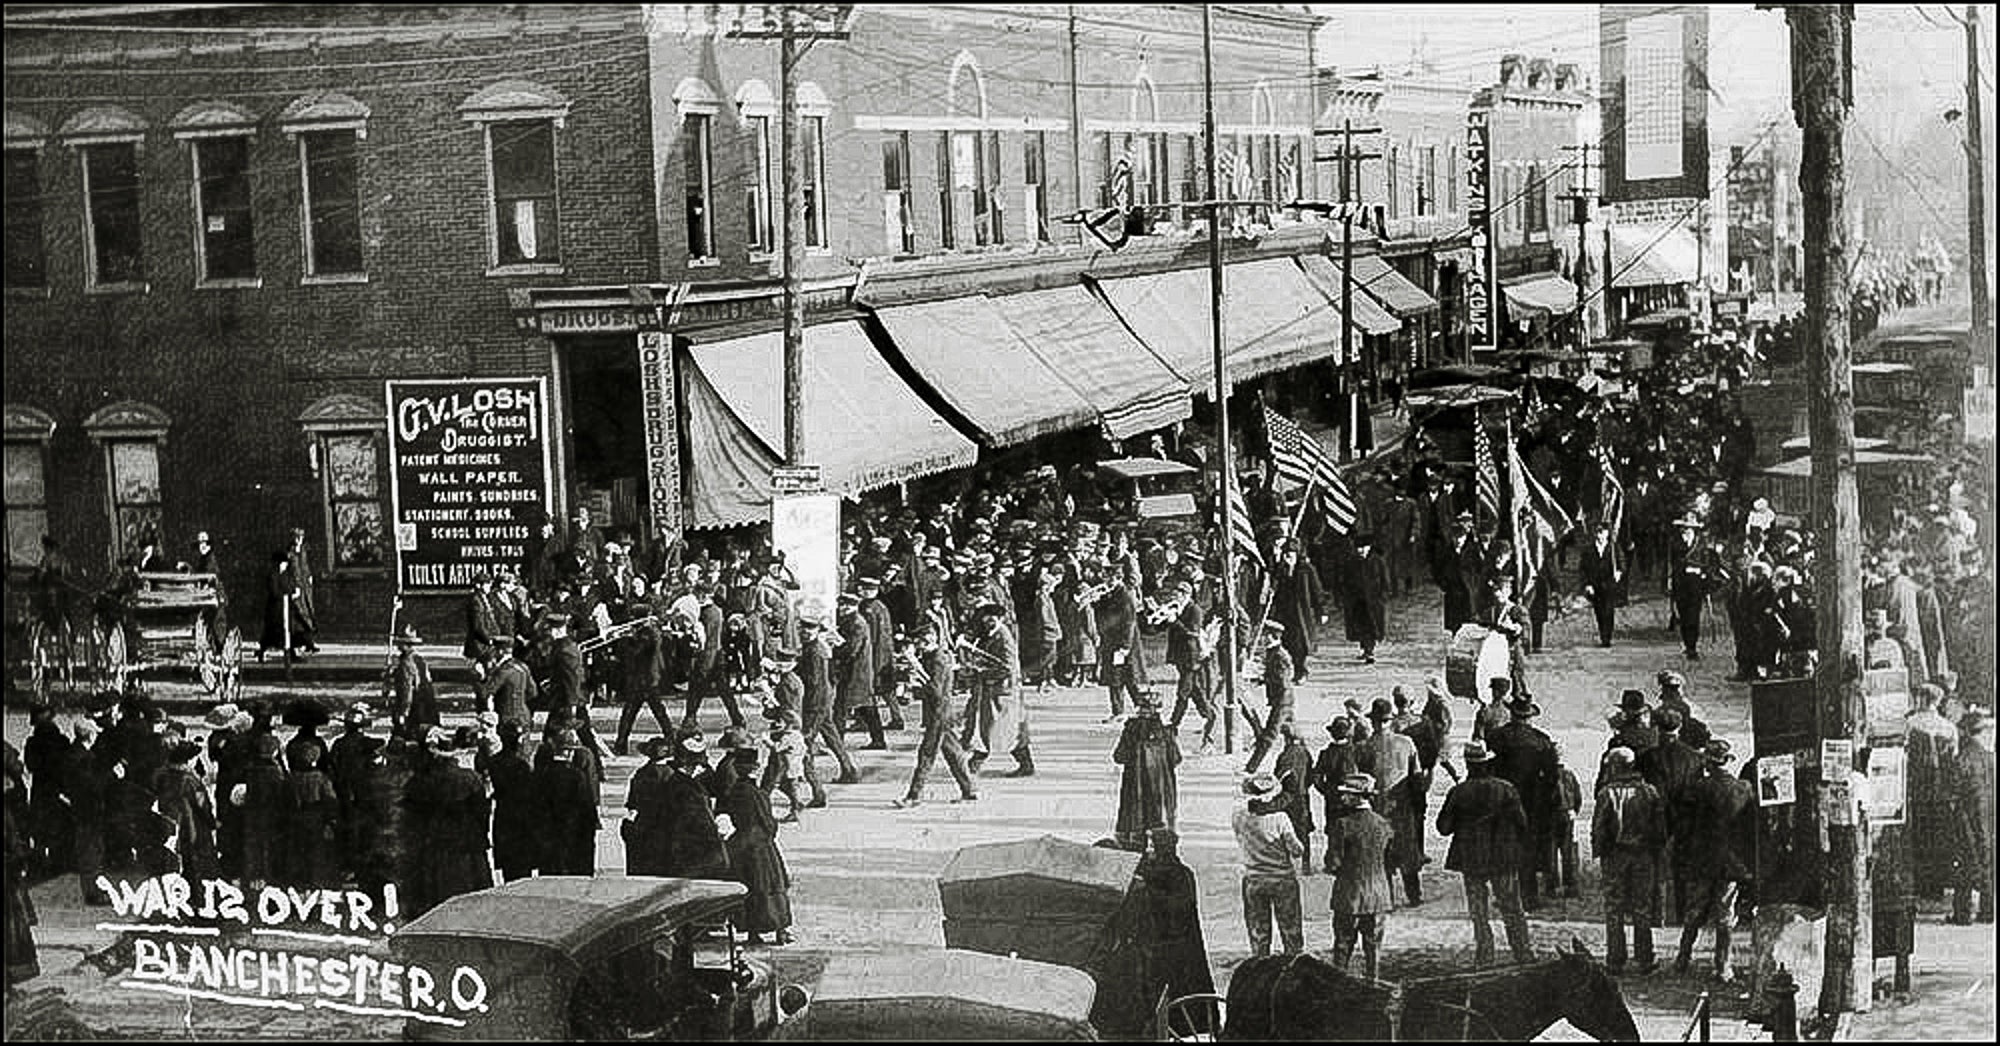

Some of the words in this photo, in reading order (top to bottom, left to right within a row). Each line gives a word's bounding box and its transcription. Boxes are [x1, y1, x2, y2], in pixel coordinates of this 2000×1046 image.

[401, 454, 440, 466] PATENT
[418, 472, 459, 485] WALL
[431, 527, 471, 539] SCHOOL
[475, 526, 529, 539] SUPPLIES
[408, 564, 445, 585] TOILET
